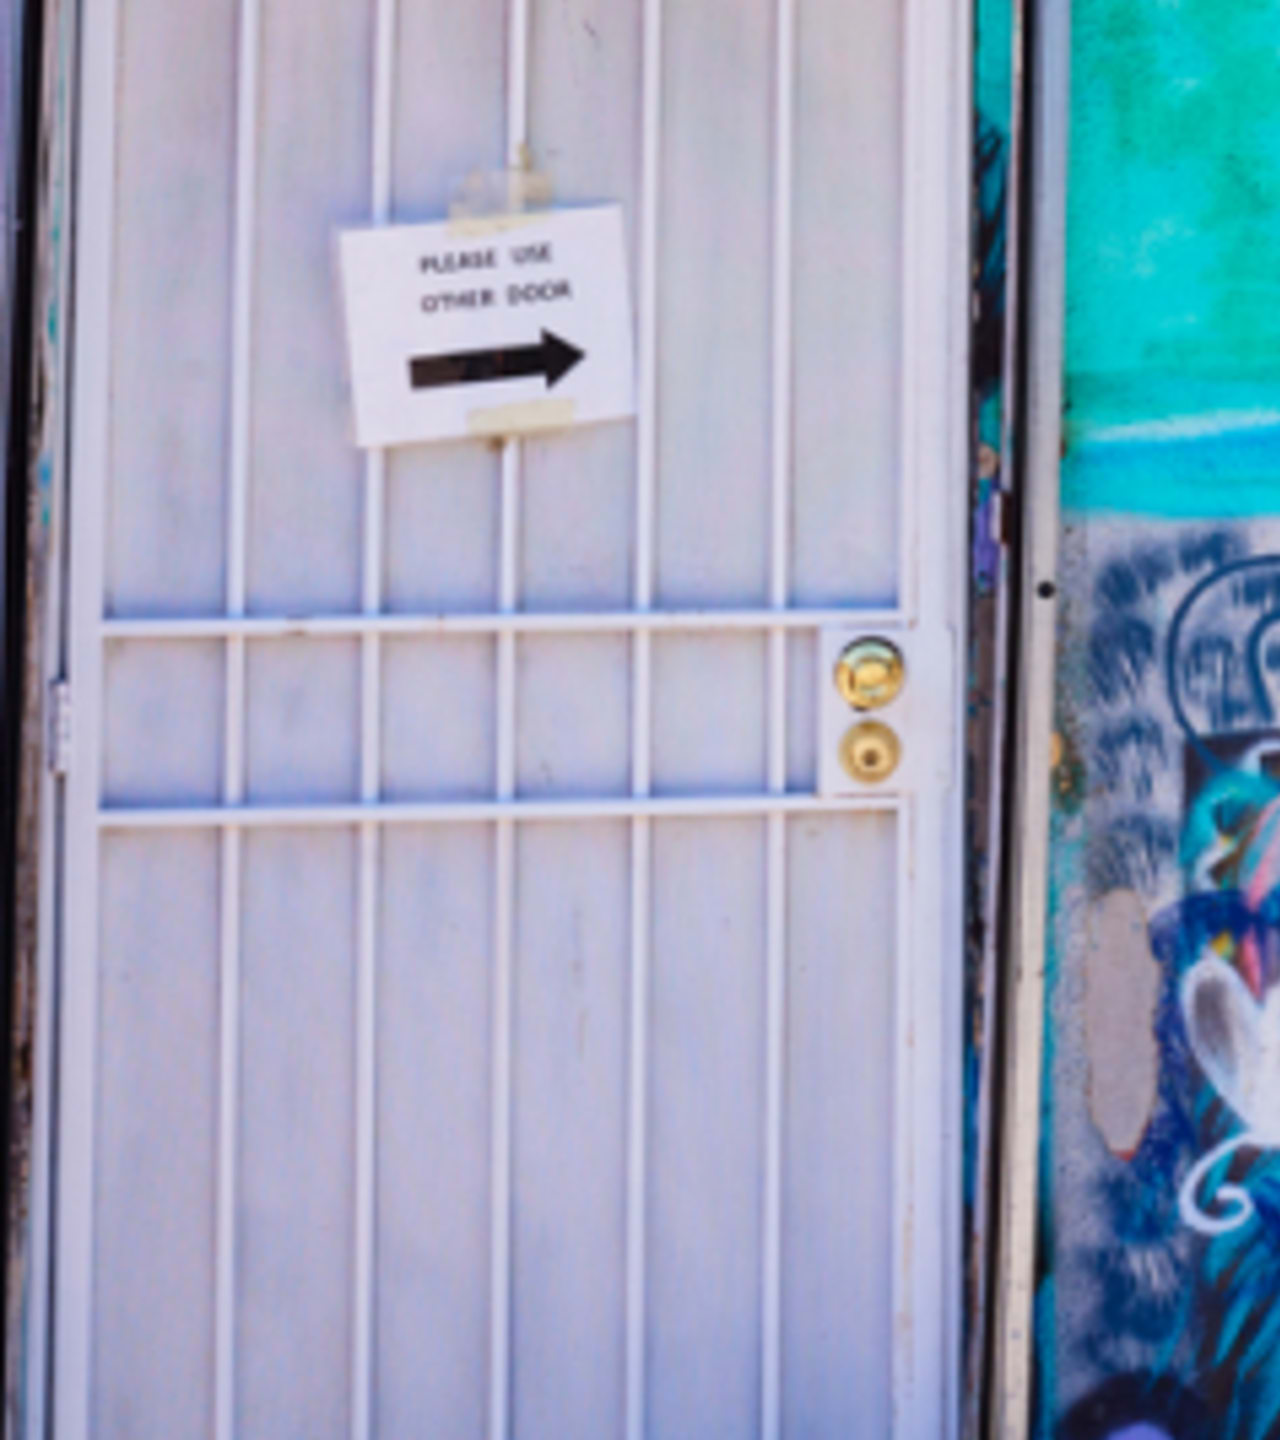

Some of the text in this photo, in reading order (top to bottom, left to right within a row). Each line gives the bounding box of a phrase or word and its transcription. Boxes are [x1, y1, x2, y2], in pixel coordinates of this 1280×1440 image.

[418, 241, 552, 275] PLEASE USE
[419, 278, 572, 314] OTHER DOOR
